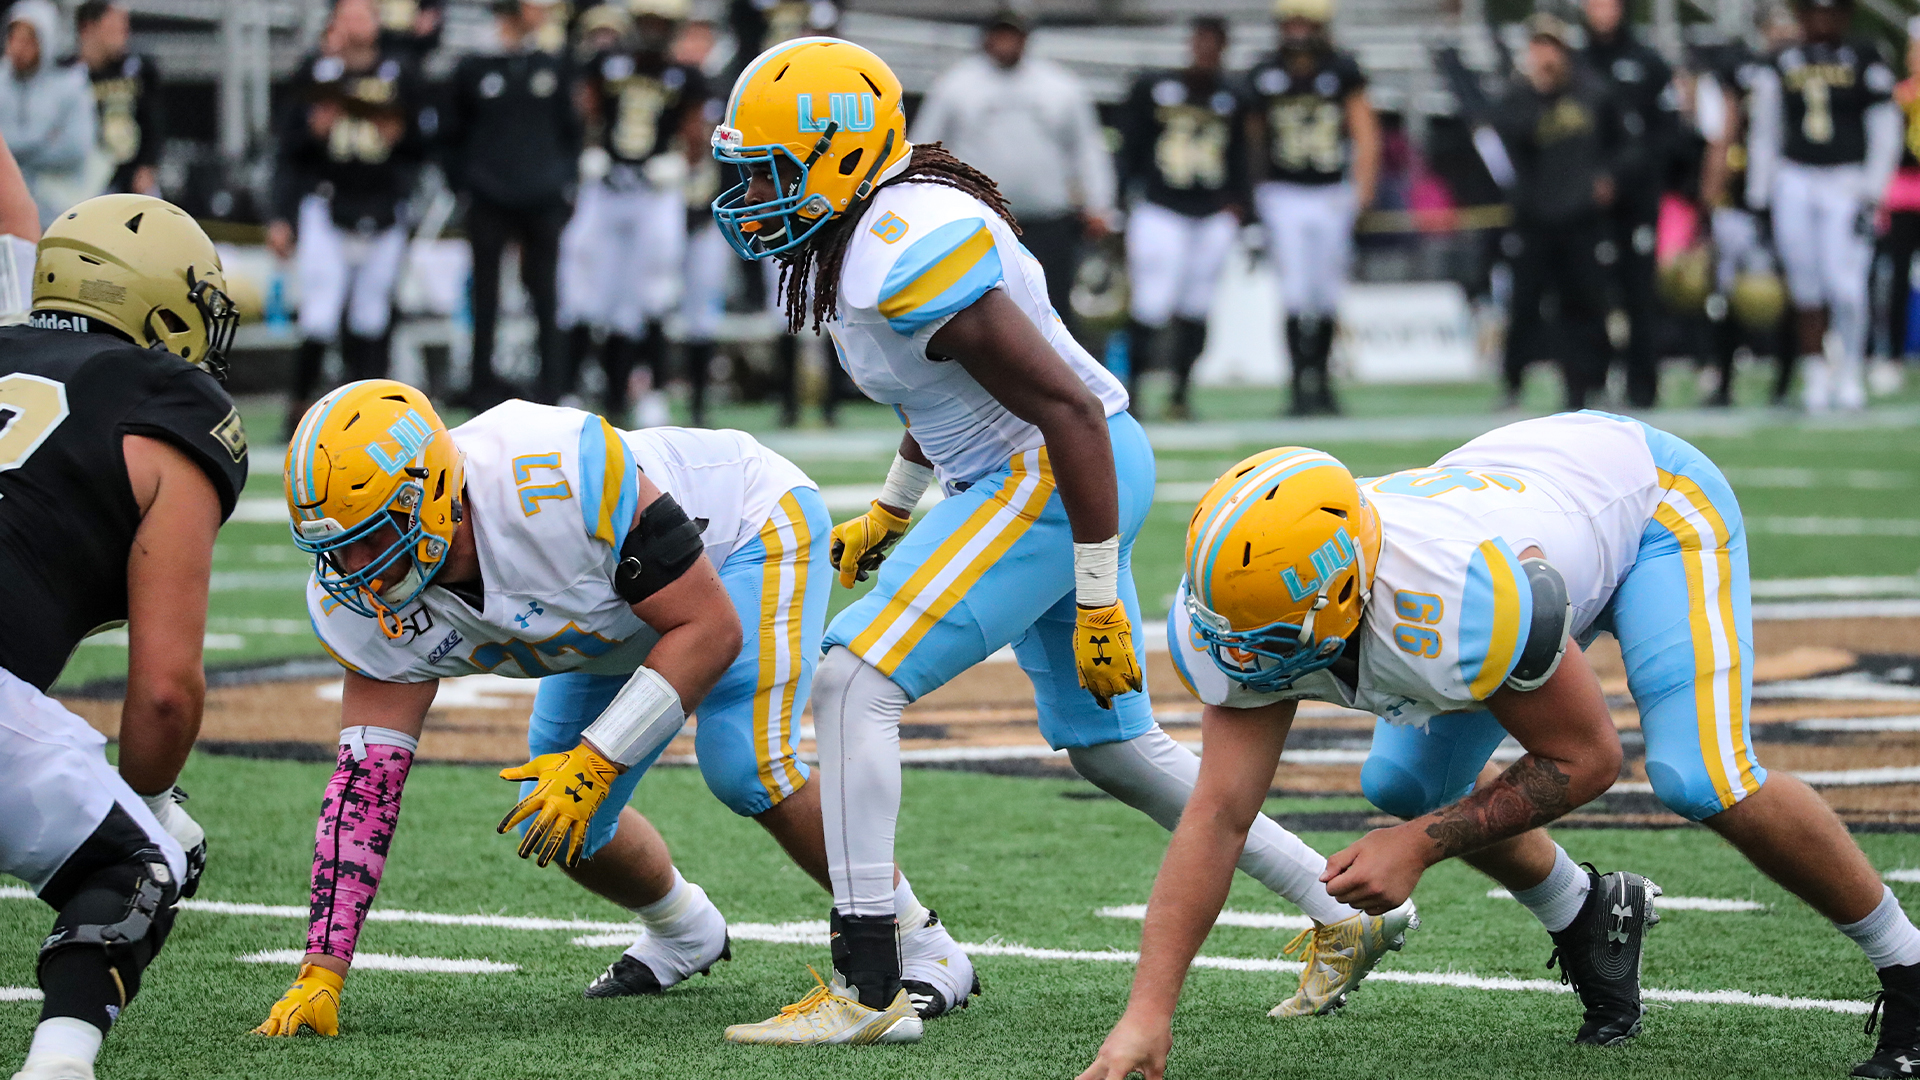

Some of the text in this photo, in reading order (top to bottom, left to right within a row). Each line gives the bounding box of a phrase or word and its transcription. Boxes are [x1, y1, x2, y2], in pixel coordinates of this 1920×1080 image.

[797, 92, 875, 133] LIU
[870, 210, 909, 244] 5
[364, 408, 435, 477] LIU
[512, 452, 573, 517] 77
[1279, 526, 1355, 604] LIU
[428, 630, 463, 665] NEC
